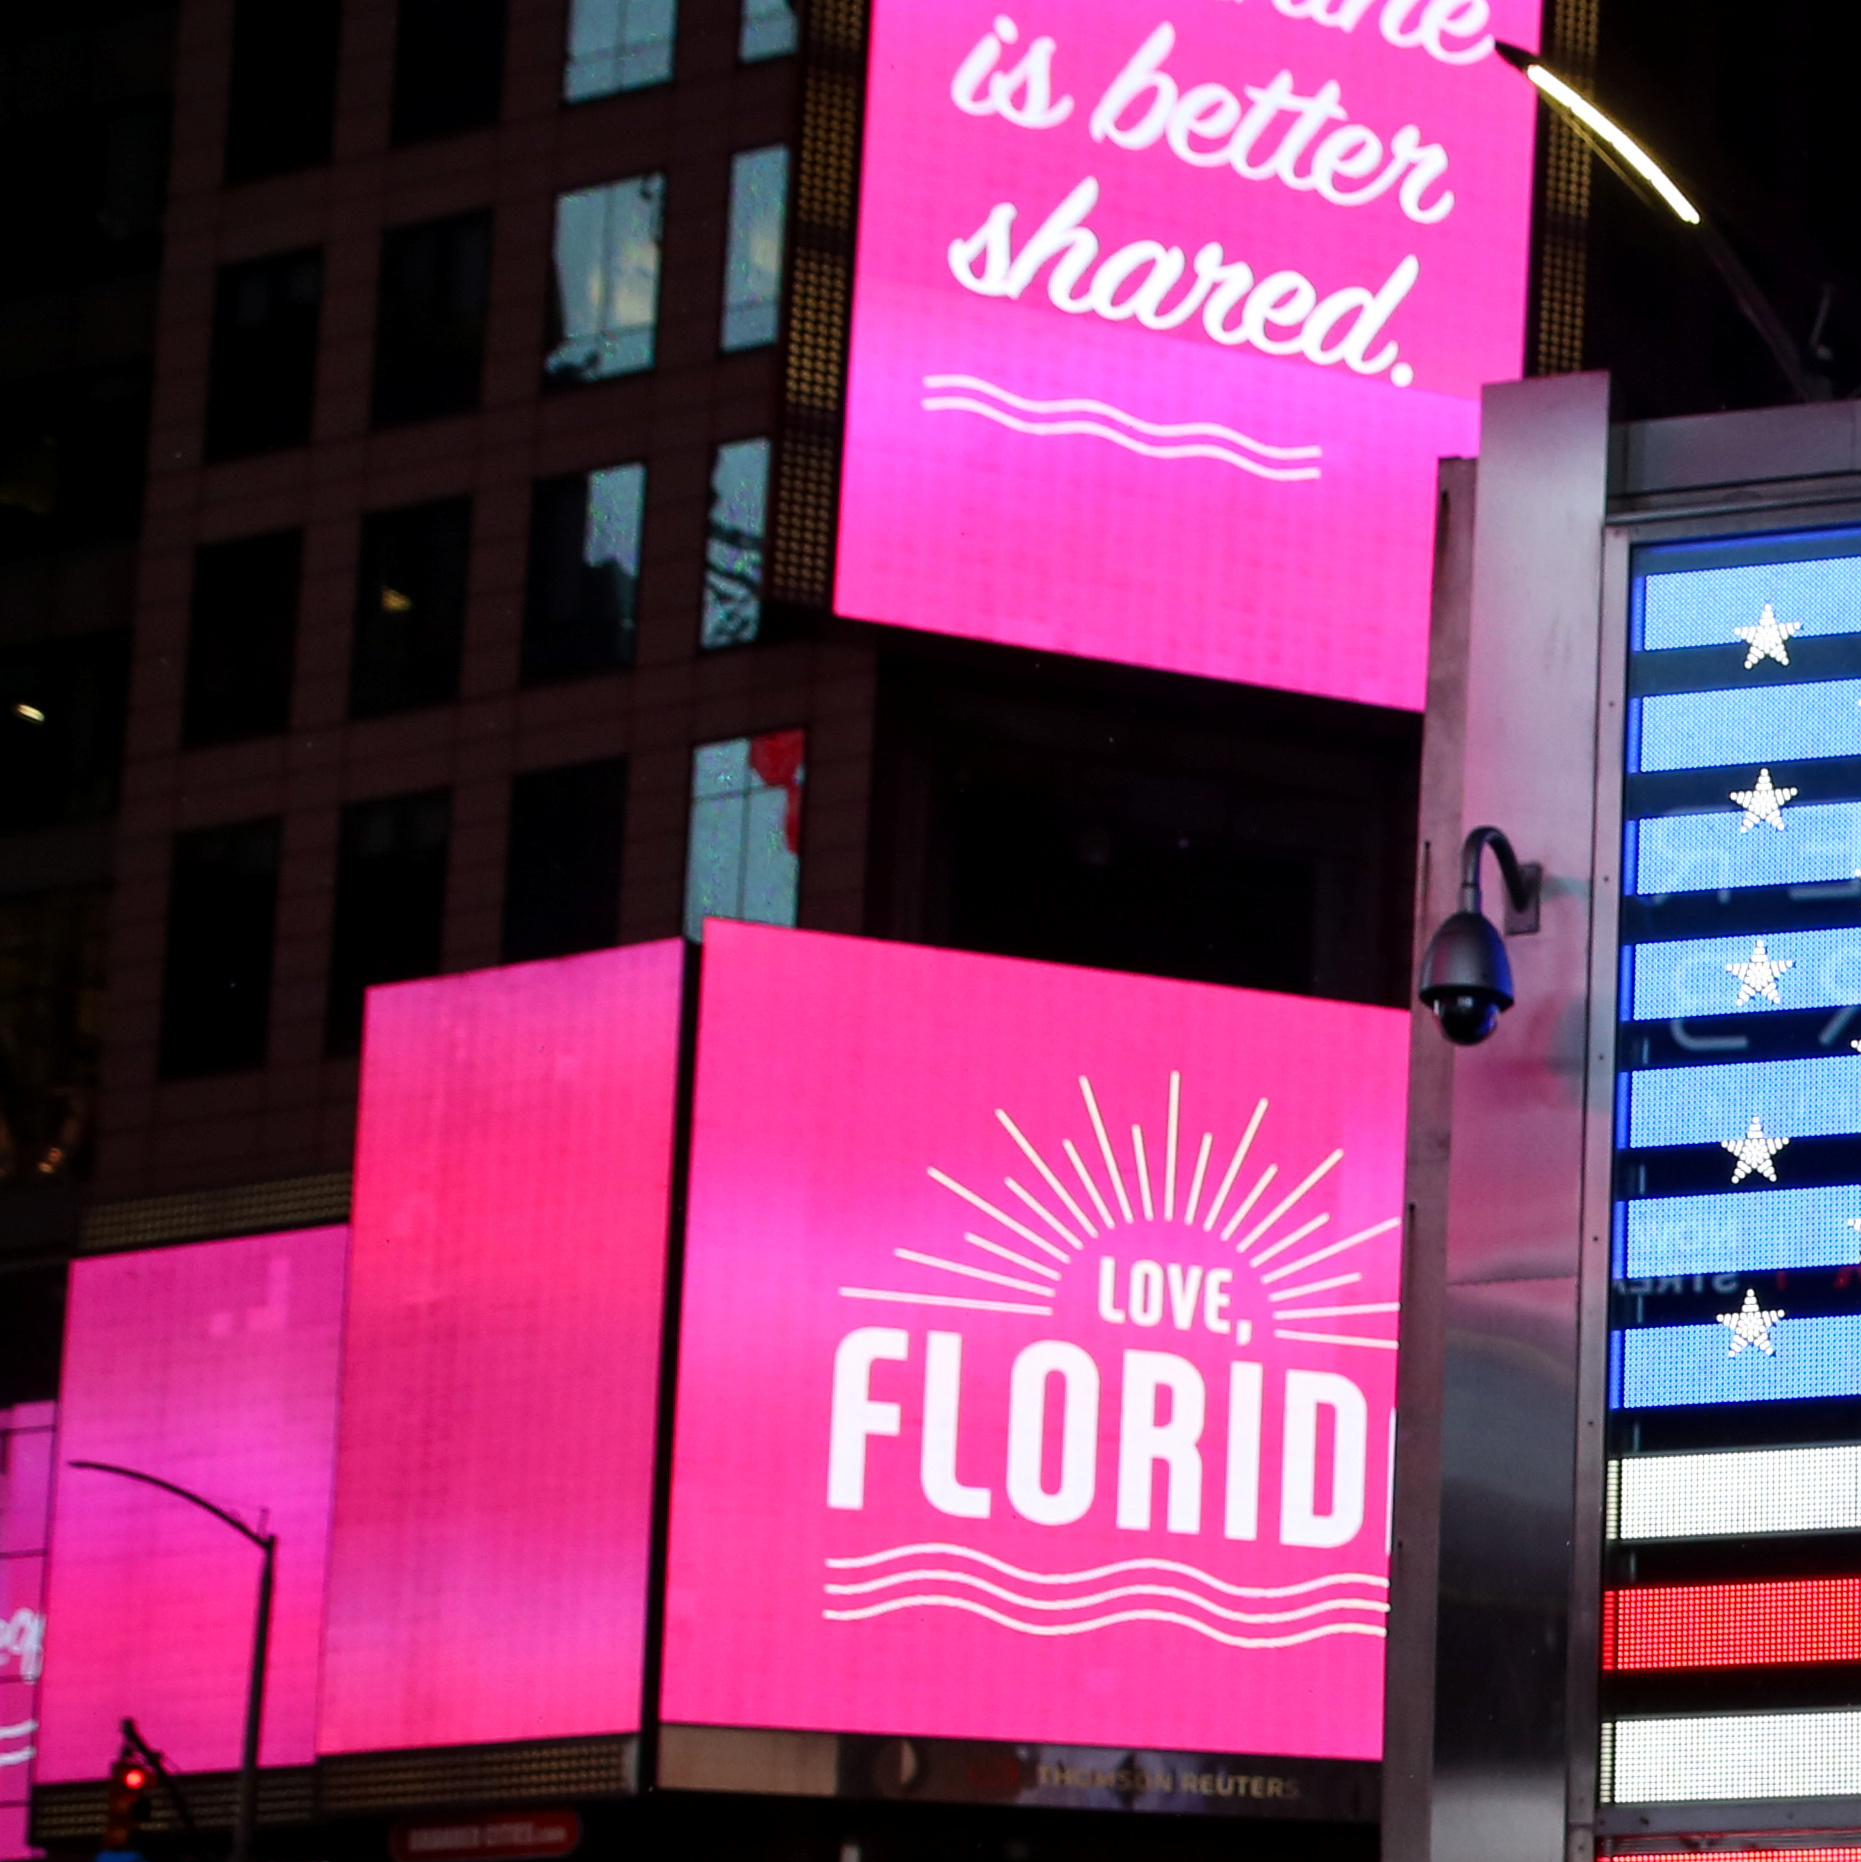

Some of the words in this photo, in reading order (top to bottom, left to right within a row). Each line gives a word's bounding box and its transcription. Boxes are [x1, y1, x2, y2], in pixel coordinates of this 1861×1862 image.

[951, 15, 1075, 129] is
[1089, 20, 1456, 224] better
[947, 176, 1421, 387] shared.
[1098, 1255, 1253, 1347] LOVE,
[827, 1325, 1397, 1554] FLORID
[1037, 1764, 1174, 1794] THOMSON
[1181, 1769, 1303, 1800] REUTERS
